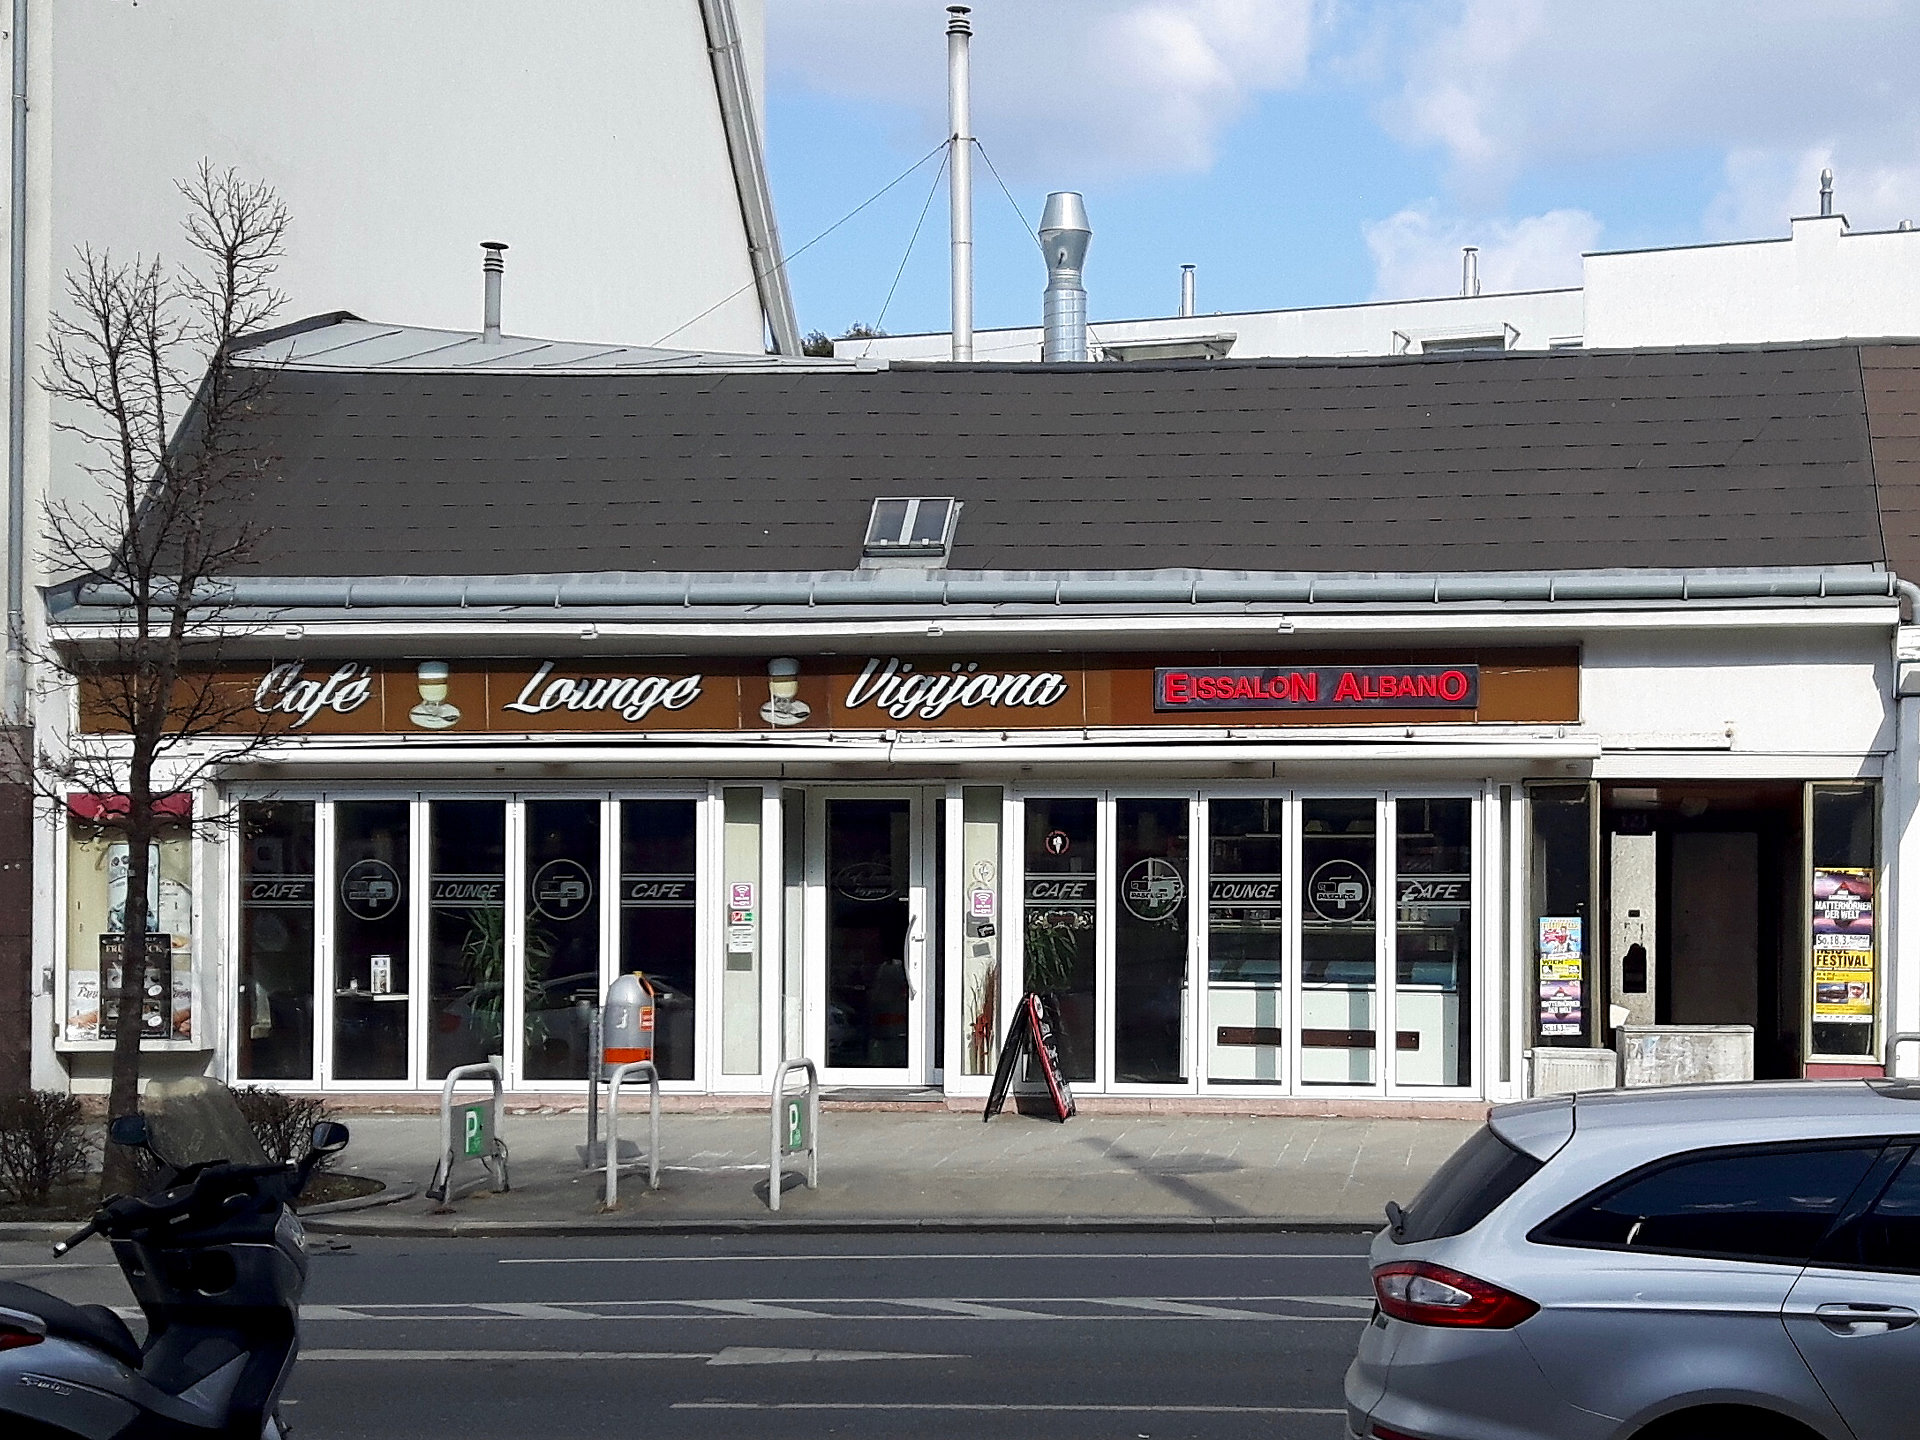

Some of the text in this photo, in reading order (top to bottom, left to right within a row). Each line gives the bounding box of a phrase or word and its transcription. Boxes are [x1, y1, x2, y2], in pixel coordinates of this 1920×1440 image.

[253, 661, 372, 729] Café
[503, 660, 702, 721] Lounge
[1164, 670, 1468, 703] EISSALON ALBANO
[251, 883, 305, 898] CAFE
[436, 883, 500, 898] LOUNGE
[631, 883, 686, 898] CAFE
[1032, 882, 1087, 898] CAFE
[1212, 883, 1279, 899] LOUNGE
[1405, 883, 1462, 899] CAFE
[1816, 954, 1868, 967] FESTIVAL
[465, 1110, 478, 1153] P
[789, 1103, 799, 1146] P
